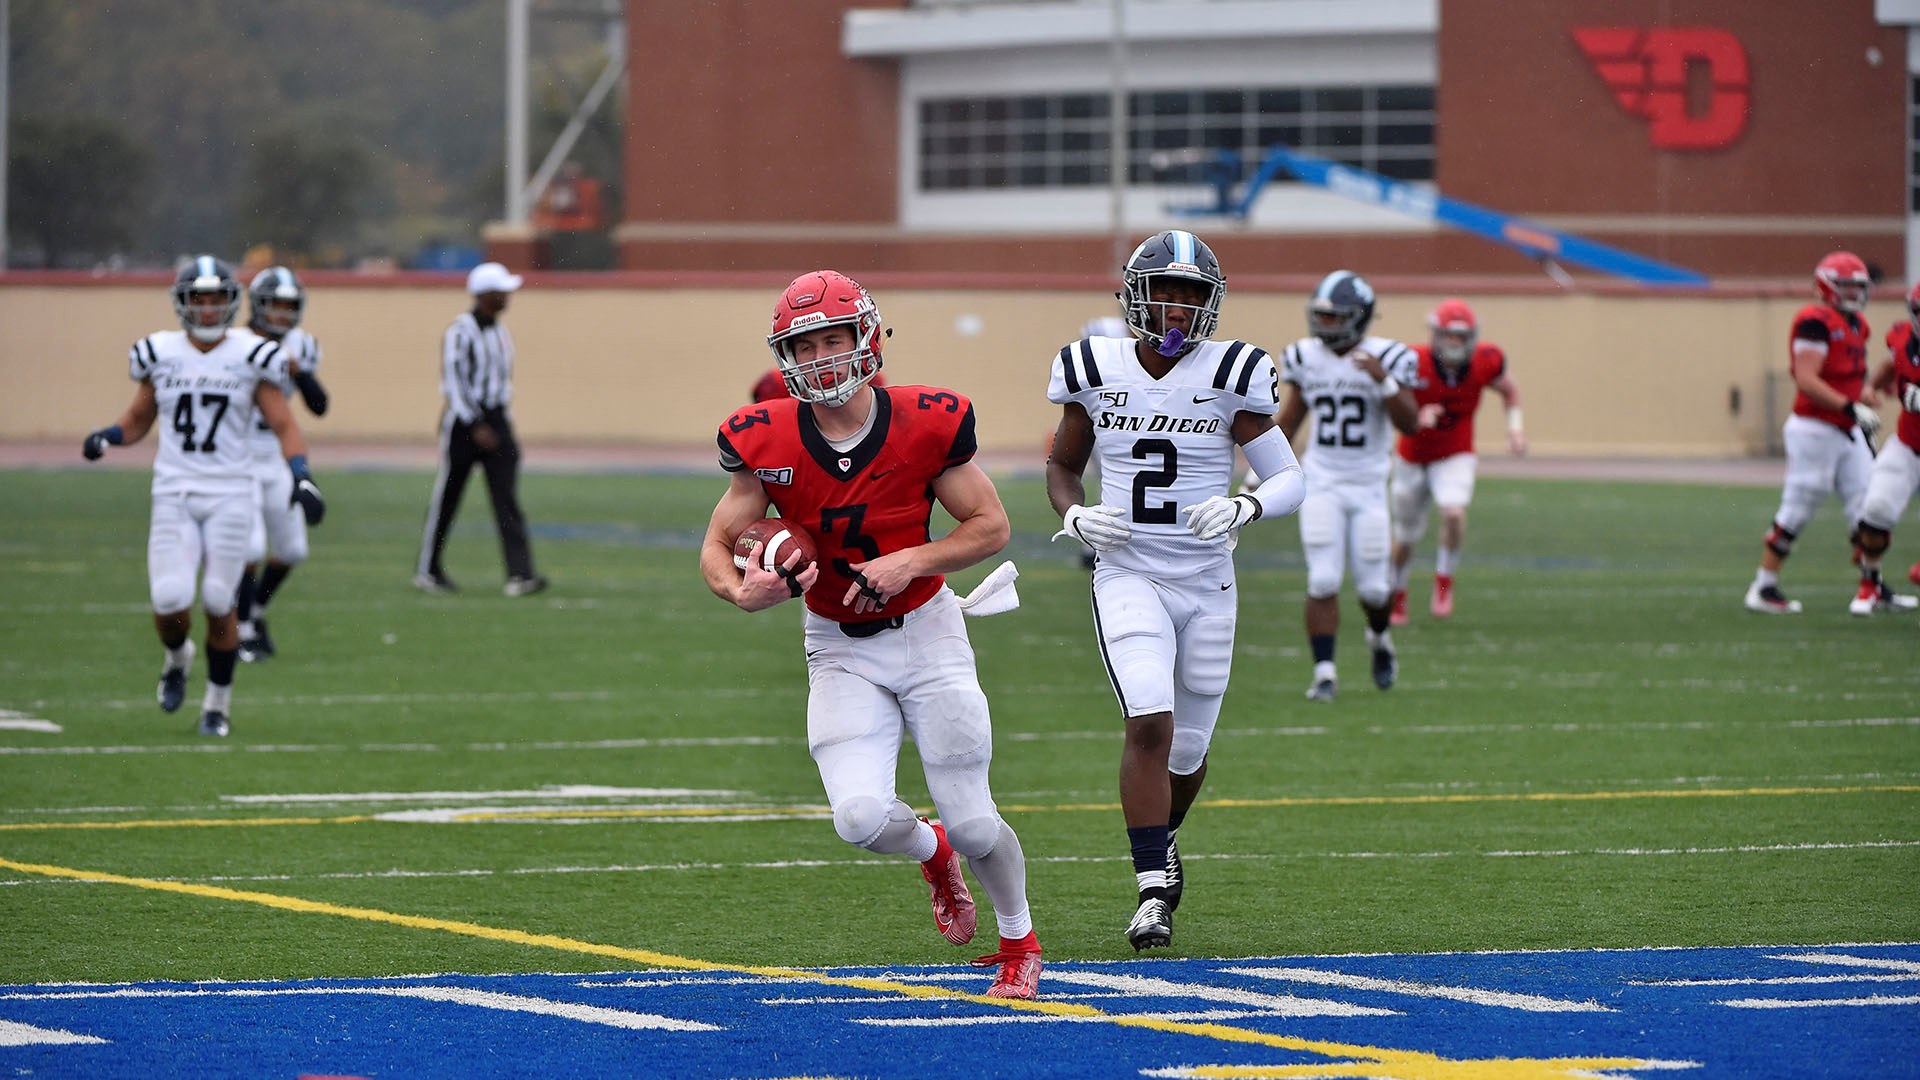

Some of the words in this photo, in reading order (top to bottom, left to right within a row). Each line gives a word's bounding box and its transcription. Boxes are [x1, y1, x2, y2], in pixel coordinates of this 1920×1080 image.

[918, 391, 959, 413] 3
[1099, 391, 1129, 408] 150
[174, 394, 229, 452] 47
[728, 408, 771, 433] 3
[1097, 411, 1146, 431] SAN
[1147, 414, 1220, 433] DIEGO
[1315, 396, 1366, 447] 22
[1132, 438, 1177, 524] 2
[820, 503, 881, 578] 3
